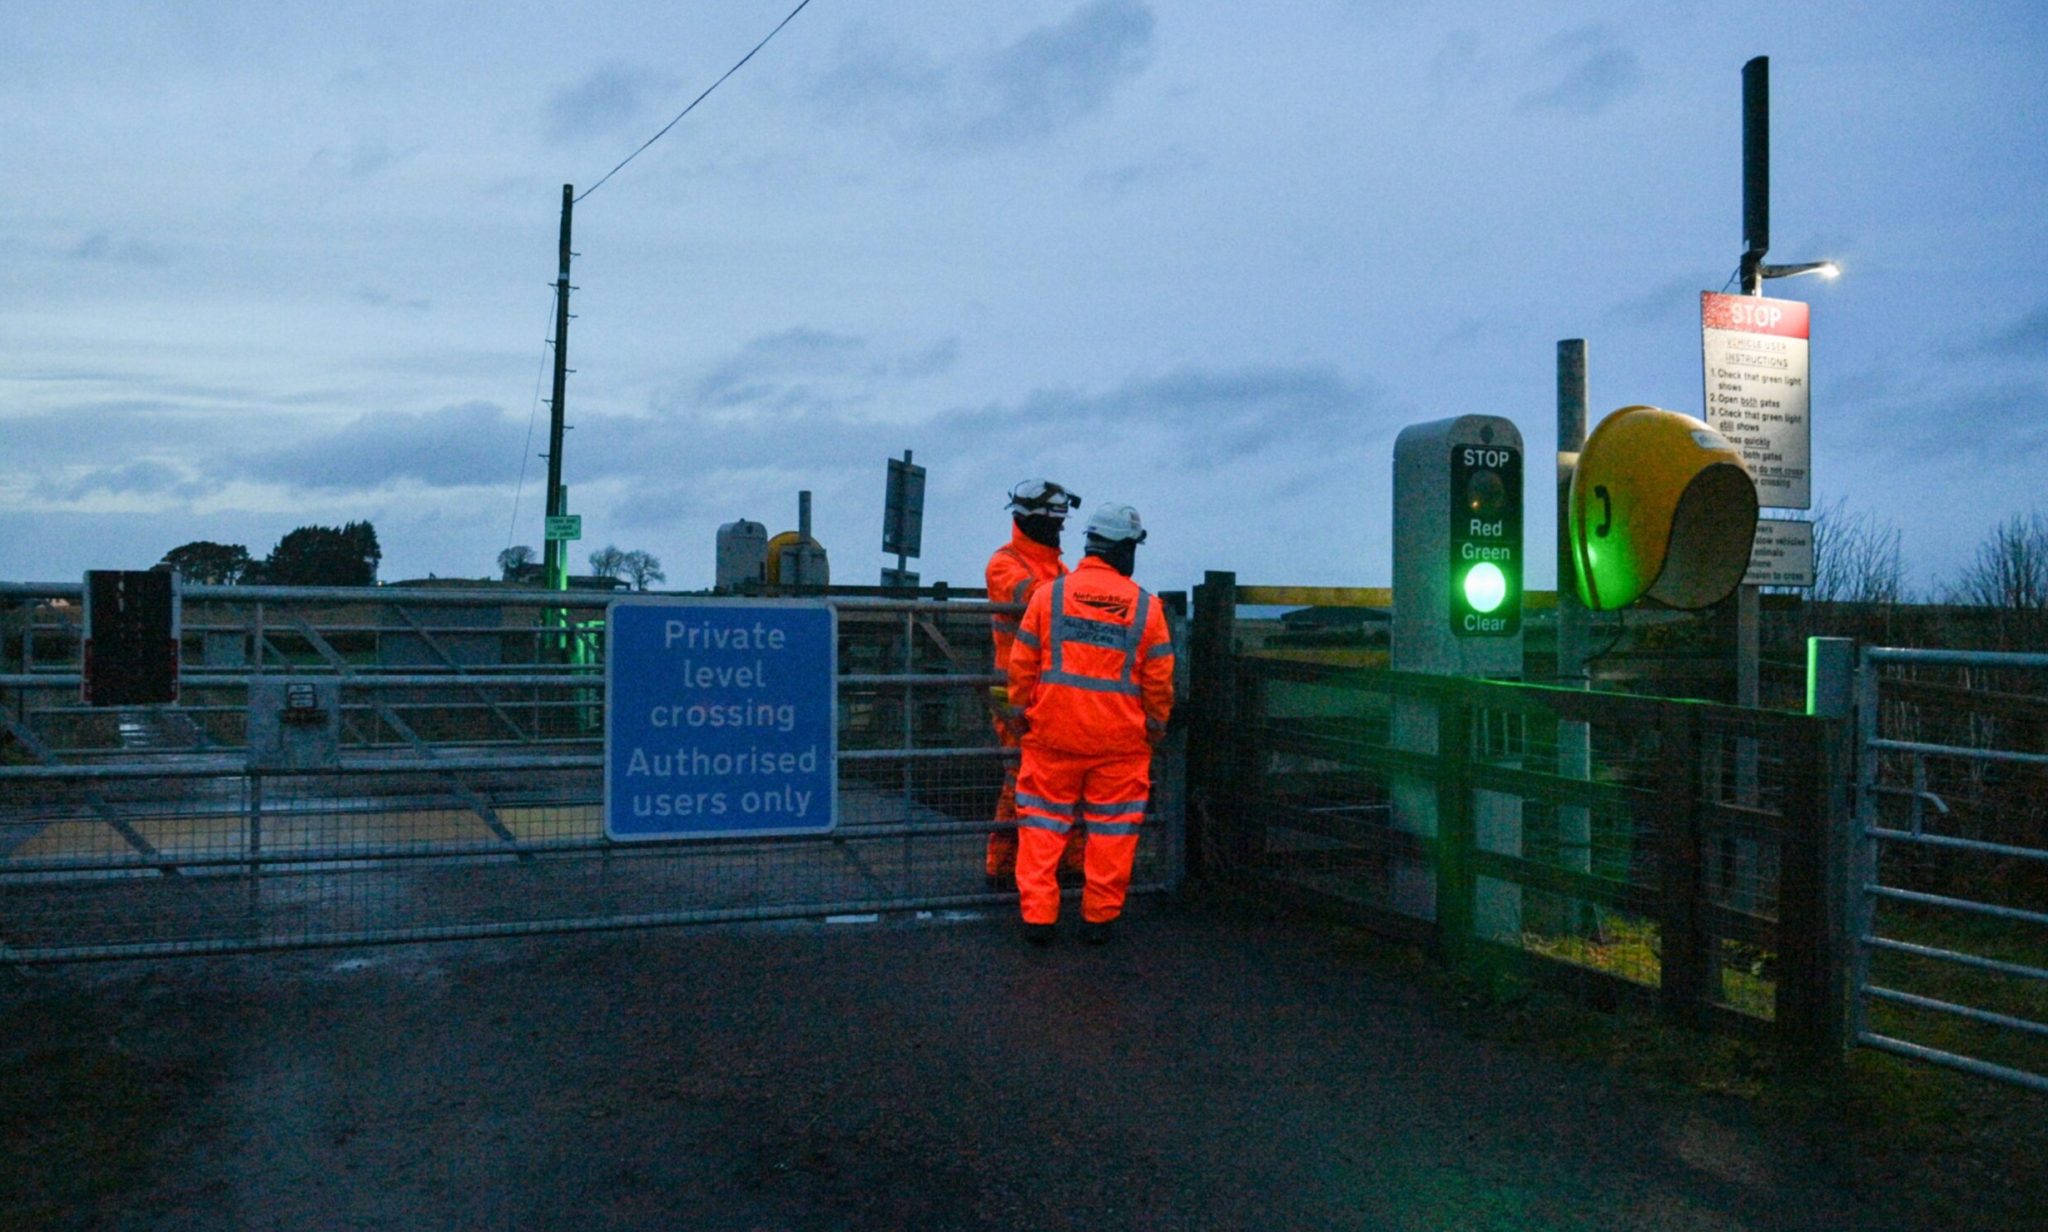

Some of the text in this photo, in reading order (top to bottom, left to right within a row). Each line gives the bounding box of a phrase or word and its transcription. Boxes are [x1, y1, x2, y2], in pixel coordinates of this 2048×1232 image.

[1731, 303, 1781, 328] STOP
[1726, 352, 1788, 368] INSTRUCTIONS
[1718, 368, 1741, 379] Check
[1744, 371, 1759, 381] that
[1762, 375, 1782, 384] green
[1785, 376, 1801, 386] light
[1718, 382, 1742, 391] shows
[1718, 393, 1738, 404] Open
[1741, 396, 1757, 406] both
[1760, 398, 1780, 408] gates
[1718, 407, 1741, 418] Check
[1744, 409, 1759, 420] that
[1762, 414, 1782, 422] green
[1785, 414, 1801, 424] light
[1719, 421, 1759, 432] still shows
[1744, 437, 1770, 447] quickly
[1464, 449, 1509, 468] STOP
[1743, 450, 1782, 462] both gates
[1759, 465, 1768, 473] do
[1760, 479, 1790, 489] crossing
[1470, 519, 1502, 536] Red
[1461, 542, 1510, 560] Green
[1773, 572, 1781, 580] to
[1464, 614, 1506, 631] Clear
[665, 620, 785, 649] Private
[684, 660, 766, 688] level
[651, 699, 794, 731] crossing
[626, 745, 816, 776] Authorised
[633, 783, 811, 817] users only
